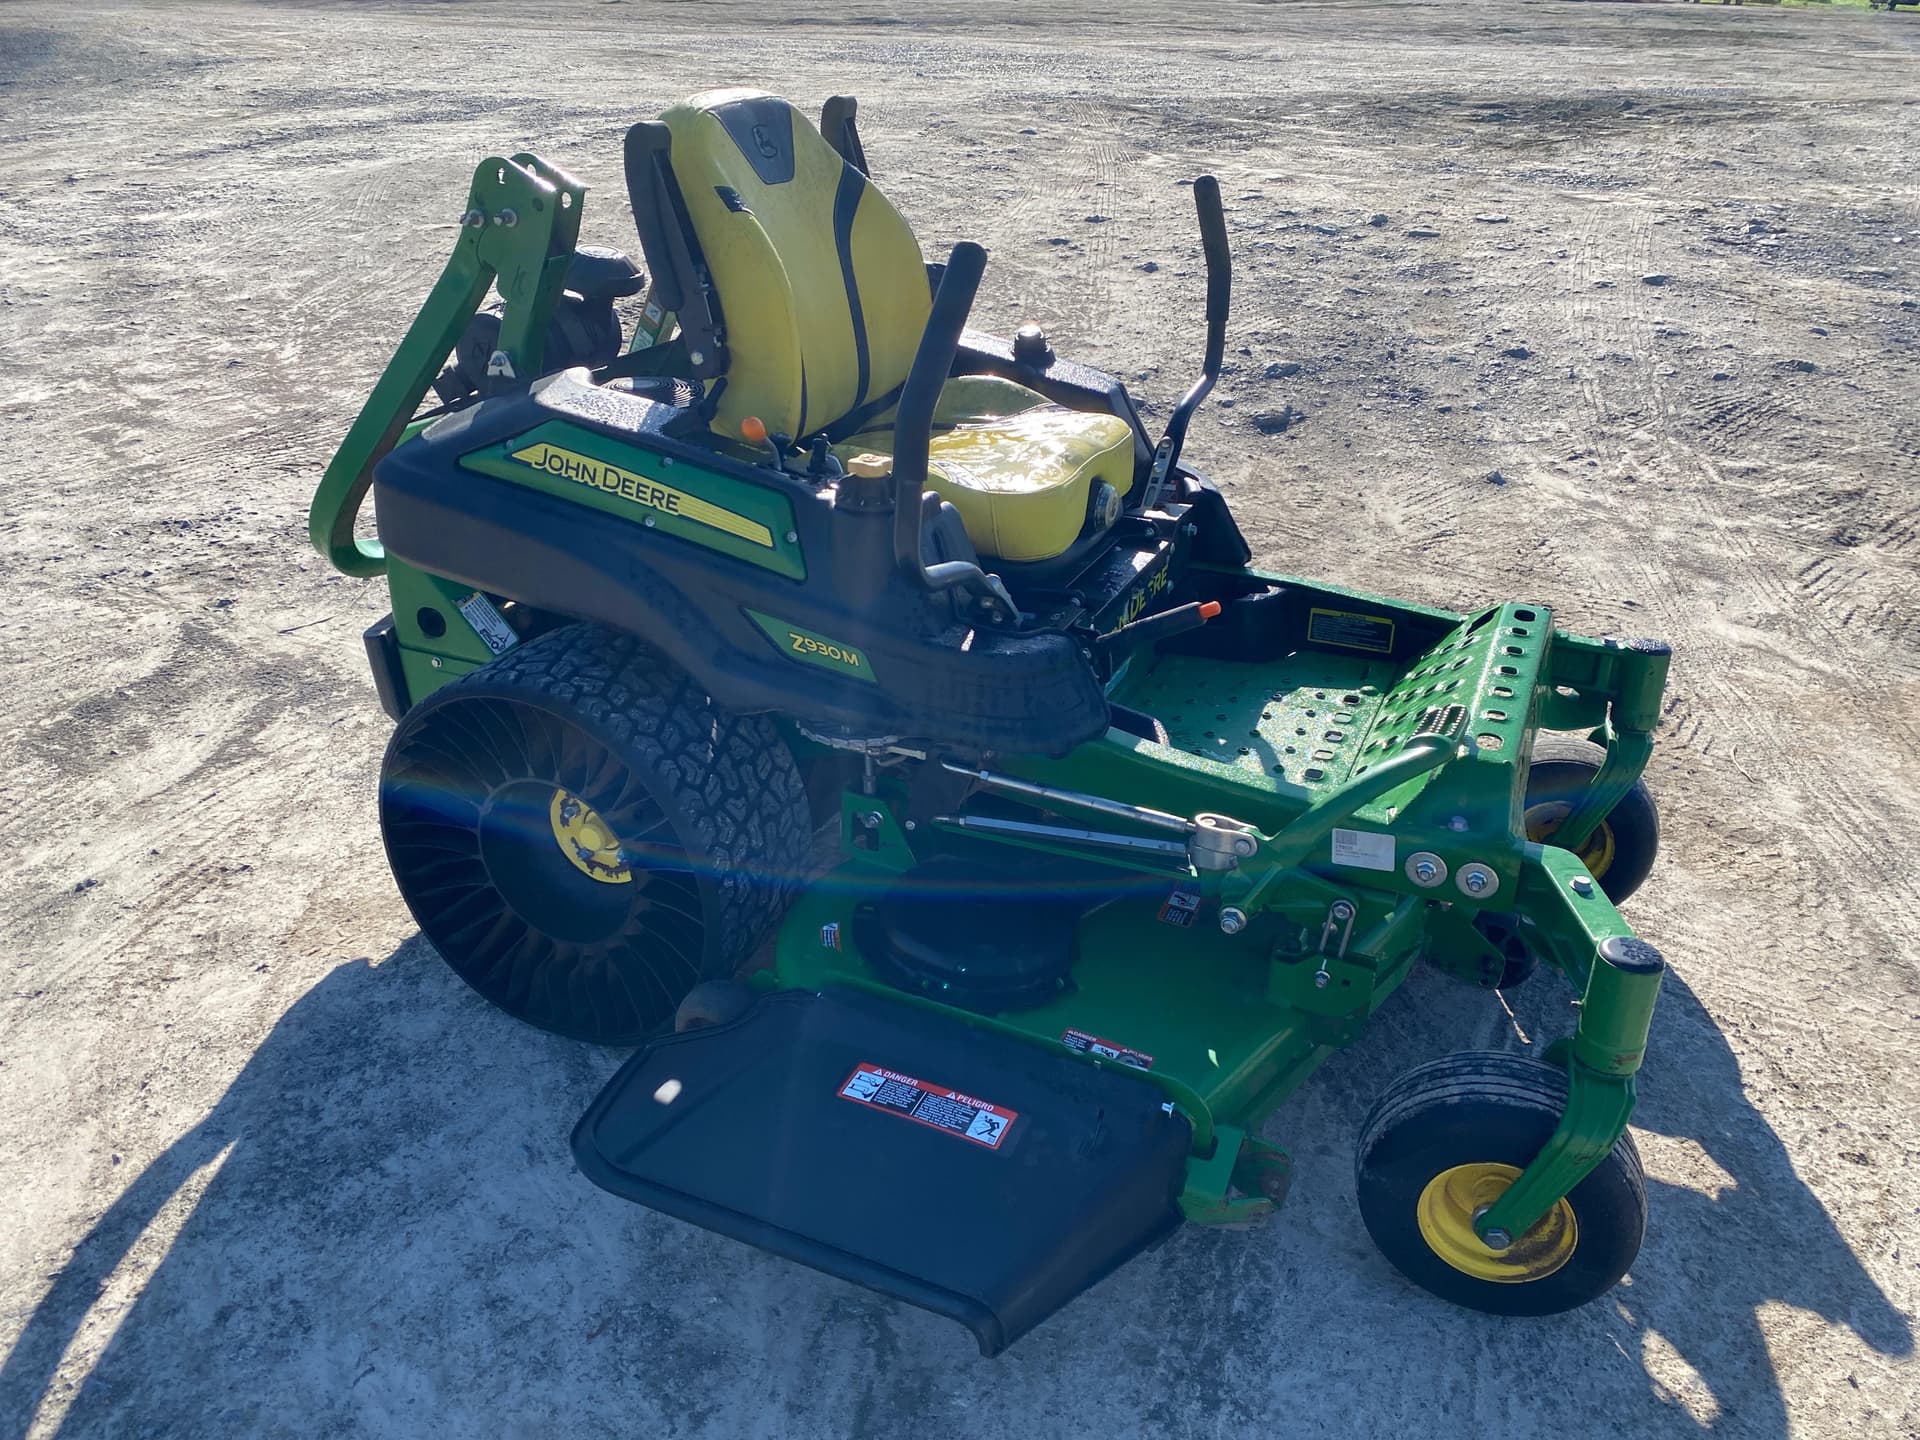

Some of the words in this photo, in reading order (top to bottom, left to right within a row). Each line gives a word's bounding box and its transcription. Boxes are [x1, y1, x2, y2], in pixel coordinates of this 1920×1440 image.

[534, 447, 597, 484] JOHN
[602, 466, 681, 513] DEERE
[788, 632, 860, 667] Z930M
[883, 1071, 919, 1087] DANGER
[956, 1094, 994, 1112] PELIGRO
